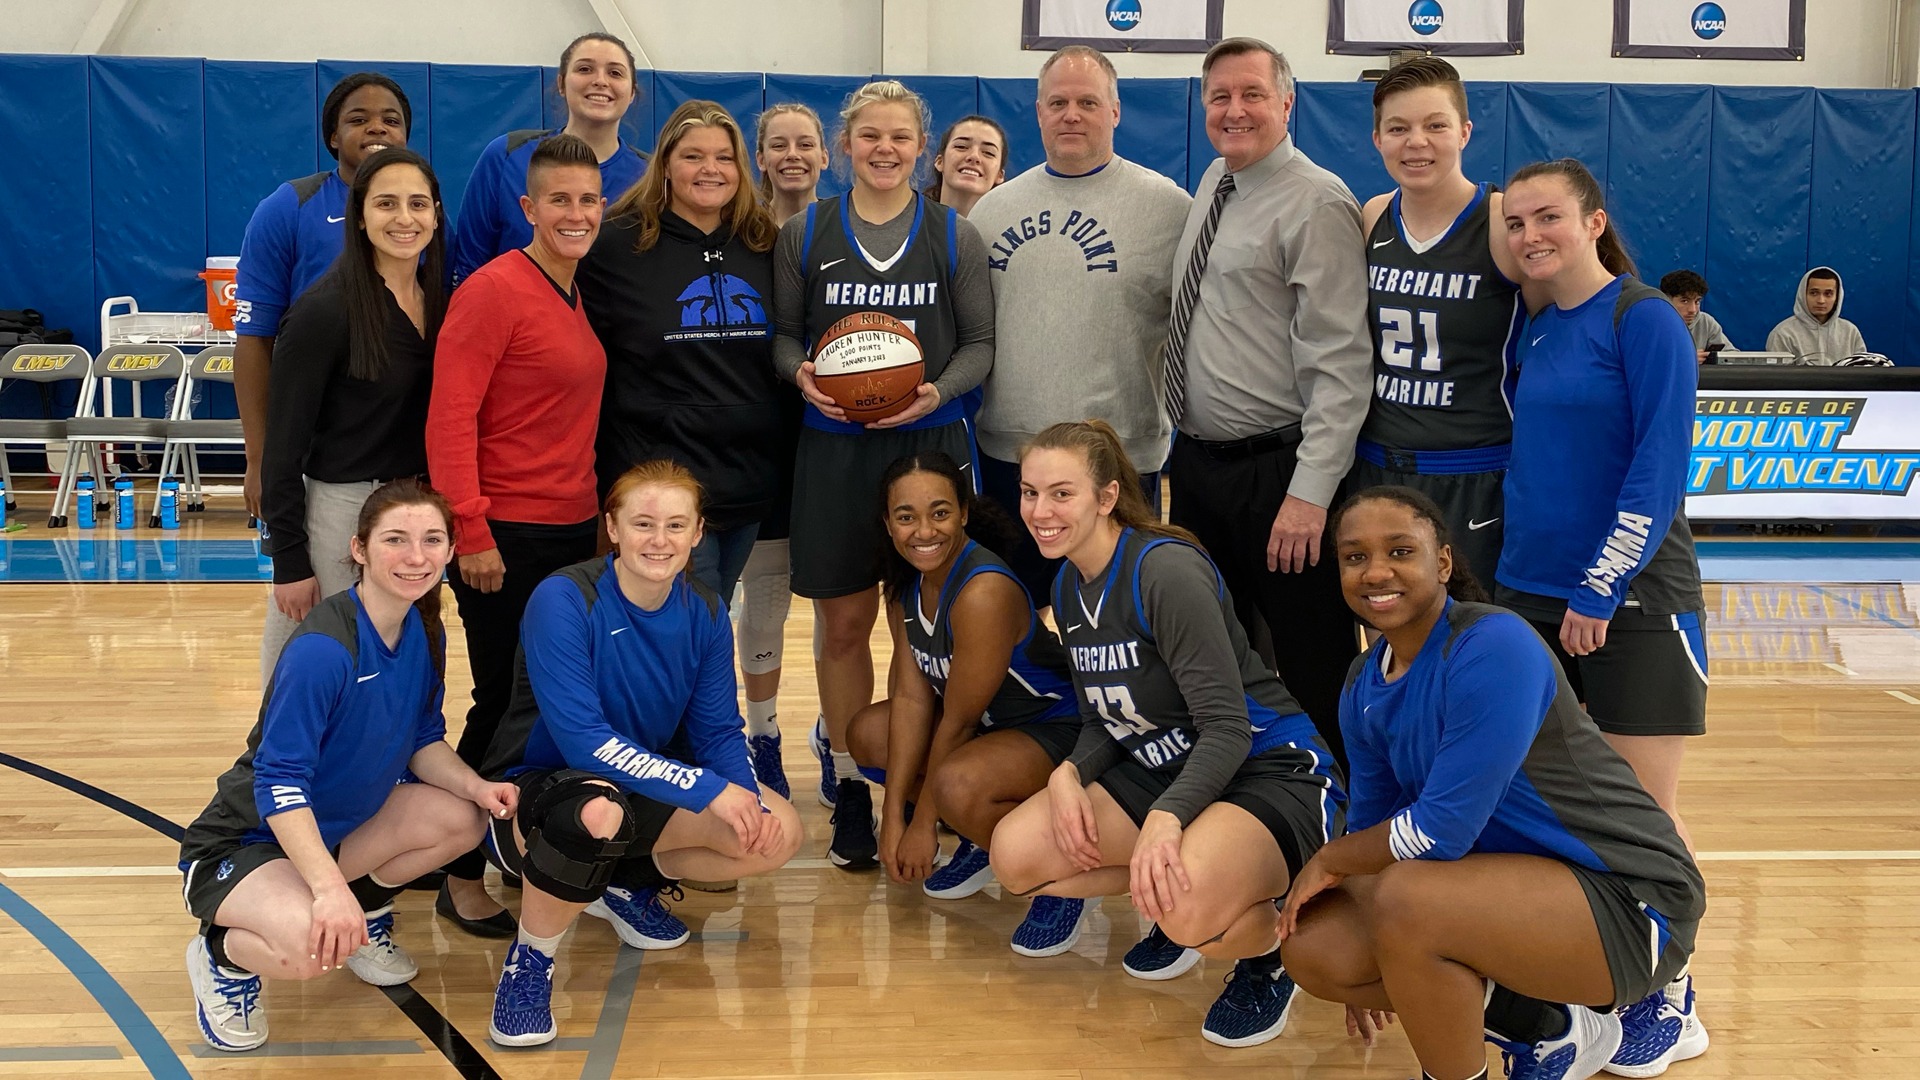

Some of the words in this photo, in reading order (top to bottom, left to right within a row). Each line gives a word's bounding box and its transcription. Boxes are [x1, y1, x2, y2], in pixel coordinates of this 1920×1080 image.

[1109, 11, 1141, 22] NCAA
[1412, 15, 1442, 26] NCAA
[1694, 20, 1725, 31] NCAA
[988, 210, 1051, 272] KINGS
[1059, 209, 1118, 273] POINT
[1368, 265, 1482, 299] MERCHANT
[825, 283, 938, 306] MERCHANT
[826, 316, 853, 338] THE
[860, 313, 900, 330] ROCK
[821, 335, 853, 361] LAUREN
[857, 332, 902, 345] HUNTER
[859, 344, 882, 353] POINTS
[1379, 307, 1442, 372] 21
[12, 354, 76, 371] CMSV
[106, 353, 170, 372] CMSV
[203, 356, 235, 373] CM
[842, 357, 867, 368] JANUARY
[855, 395, 887, 407] ROCK
[1376, 374, 1455, 407] MARINE
[1696, 400, 1810, 415] COLLEGE
[1822, 401, 1856, 415] OF
[1692, 419, 1846, 448] MOUNT
[1731, 456, 1914, 487] VINCENT
[1070, 640, 1140, 672] MERCHANT
[1084, 685, 1159, 741] 33
